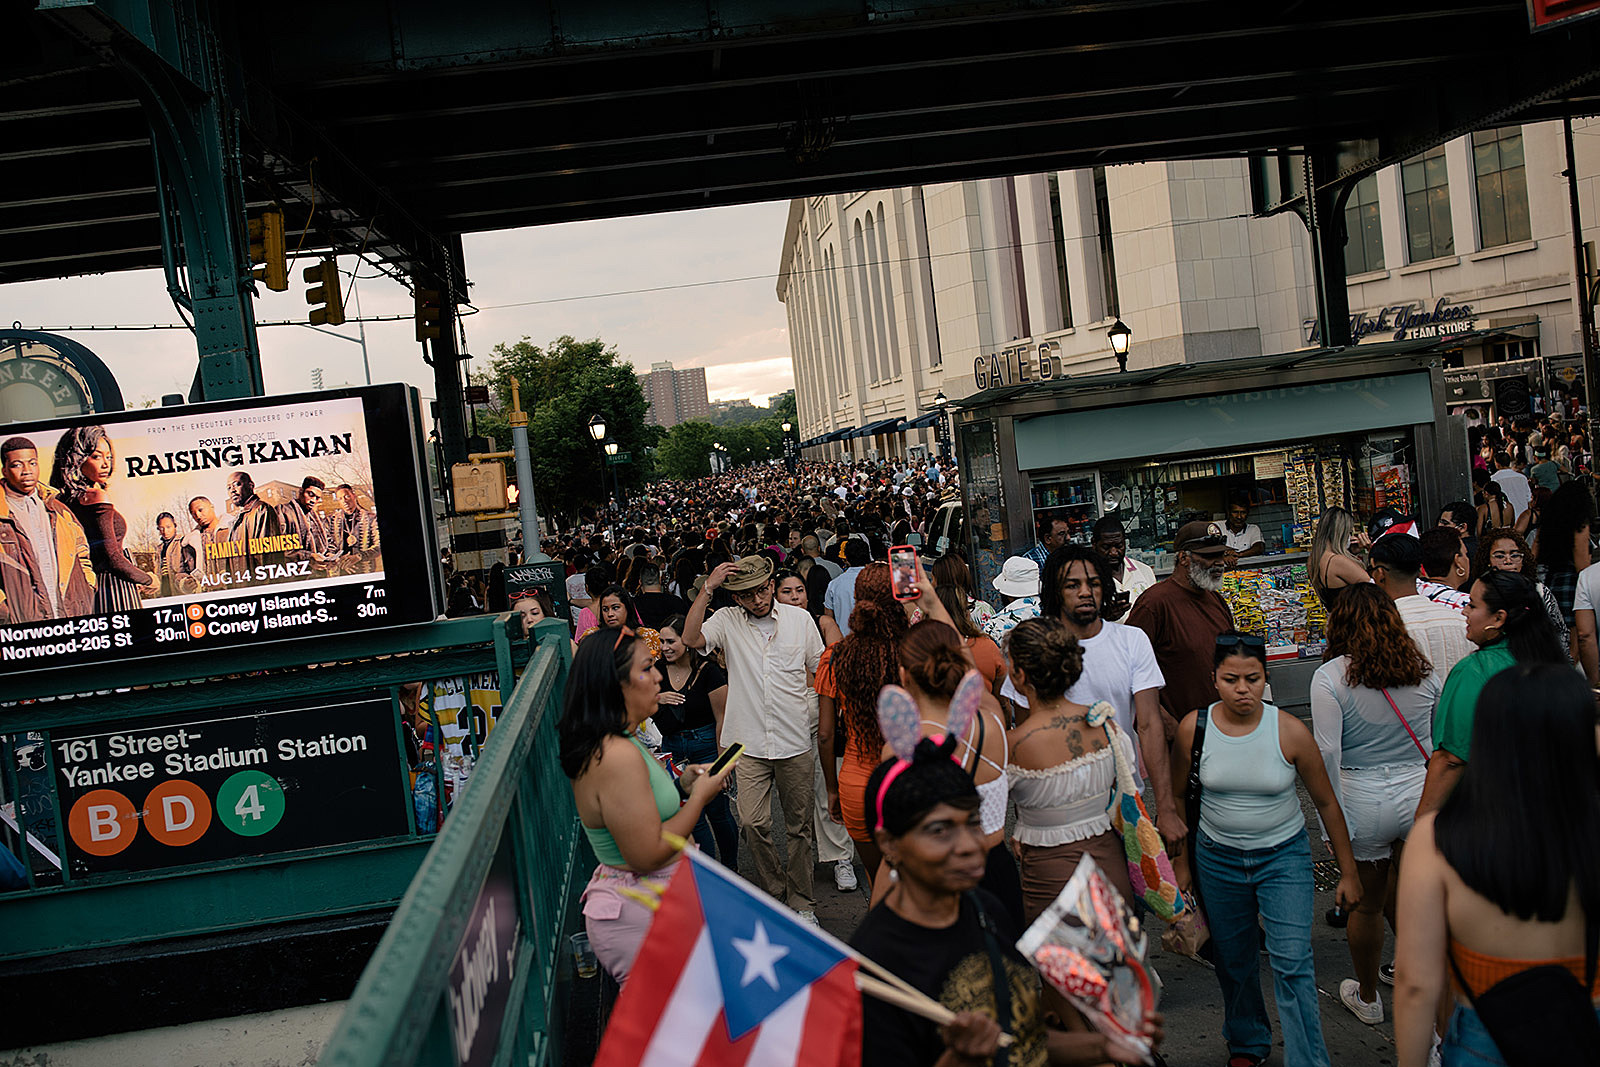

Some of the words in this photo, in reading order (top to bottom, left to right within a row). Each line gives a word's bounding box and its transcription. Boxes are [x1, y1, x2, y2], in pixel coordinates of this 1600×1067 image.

[1394, 297, 1473, 341] Yankees
[1405, 324, 1436, 341] TEAM
[1437, 320, 1473, 336] STORE
[973, 347, 1031, 391] GATE
[1037, 342, 1054, 381] 6
[147, 426, 167, 434] FROM
[190, 419, 233, 430] EXECUTIVE
[238, 413, 281, 424] PRODUCERS
[285, 412, 296, 420] OF
[299, 408, 324, 418] POWER
[124, 444, 244, 478] RAISING
[248, 432, 352, 465] KANAN
[198, 436, 234, 447] POWER
[236, 432, 266, 444] BOOK
[205, 540, 247, 560] FAMILY.
[249, 533, 304, 555] BUSINESS.
[200, 572, 233, 587] AUG
[234, 569, 251, 583] 14
[255, 560, 312, 581] STARZ
[205, 601, 257, 618] Coney
[261, 590, 336, 611] Island-S..
[363, 585, 386, 599] 7m
[0, 617, 108, 643] Norwood-205
[111, 614, 131, 630] St
[152, 608, 184, 625] 17m
[207, 618, 260, 636] Coney
[263, 608, 338, 629] Island-S..
[356, 602, 388, 618] 30m
[2, 635, 111, 661] Norwood-205
[114, 632, 134, 648] St
[154, 628, 187, 643] 30m
[57, 739, 99, 764] 161
[108, 728, 202, 758] Street-
[60, 760, 155, 788] Yankee
[164, 744, 268, 775] Stadium
[277, 732, 367, 761] Station
[87, 804, 122, 842] B
[161, 794, 196, 832] D
[234, 784, 265, 822] 4
